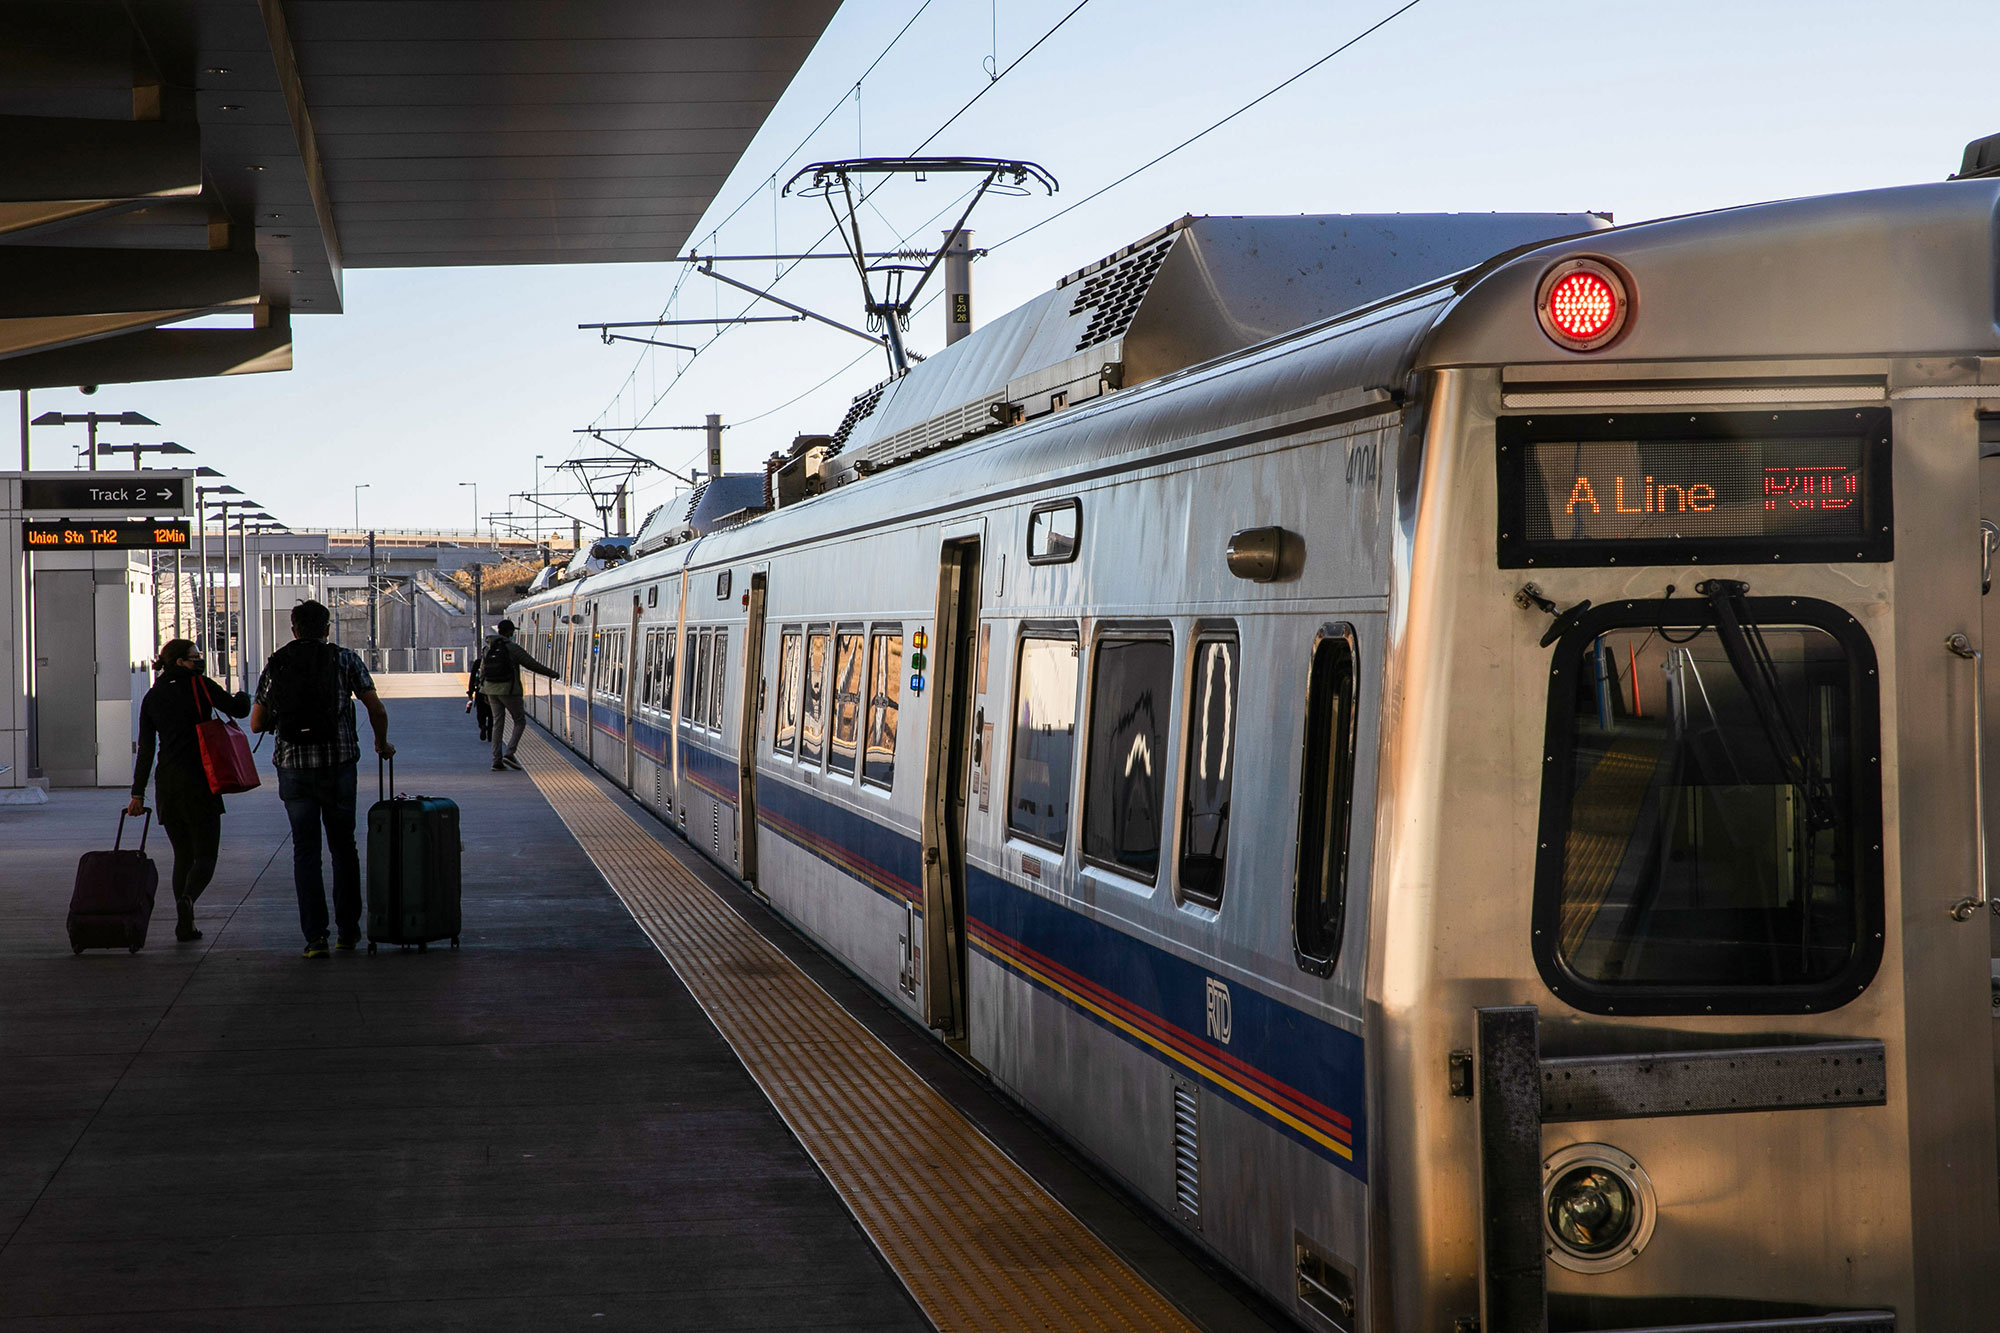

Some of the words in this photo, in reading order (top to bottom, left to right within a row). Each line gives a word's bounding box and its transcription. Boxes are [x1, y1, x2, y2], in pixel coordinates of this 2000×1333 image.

[958, 295, 964, 303] E
[957, 304, 967, 313] 23
[957, 313, 967, 322] 26
[89, 488, 129, 501] Track
[135, 488, 147, 501] 2
[1566, 477, 1600, 514] A
[1615, 475, 1716, 513] Line
[28, 530, 59, 544] Union
[64, 531, 85, 544] Stn
[90, 529, 118, 544] Trk2
[153, 529, 186, 543] 12Min
[1206, 976, 1232, 1045] RTD
